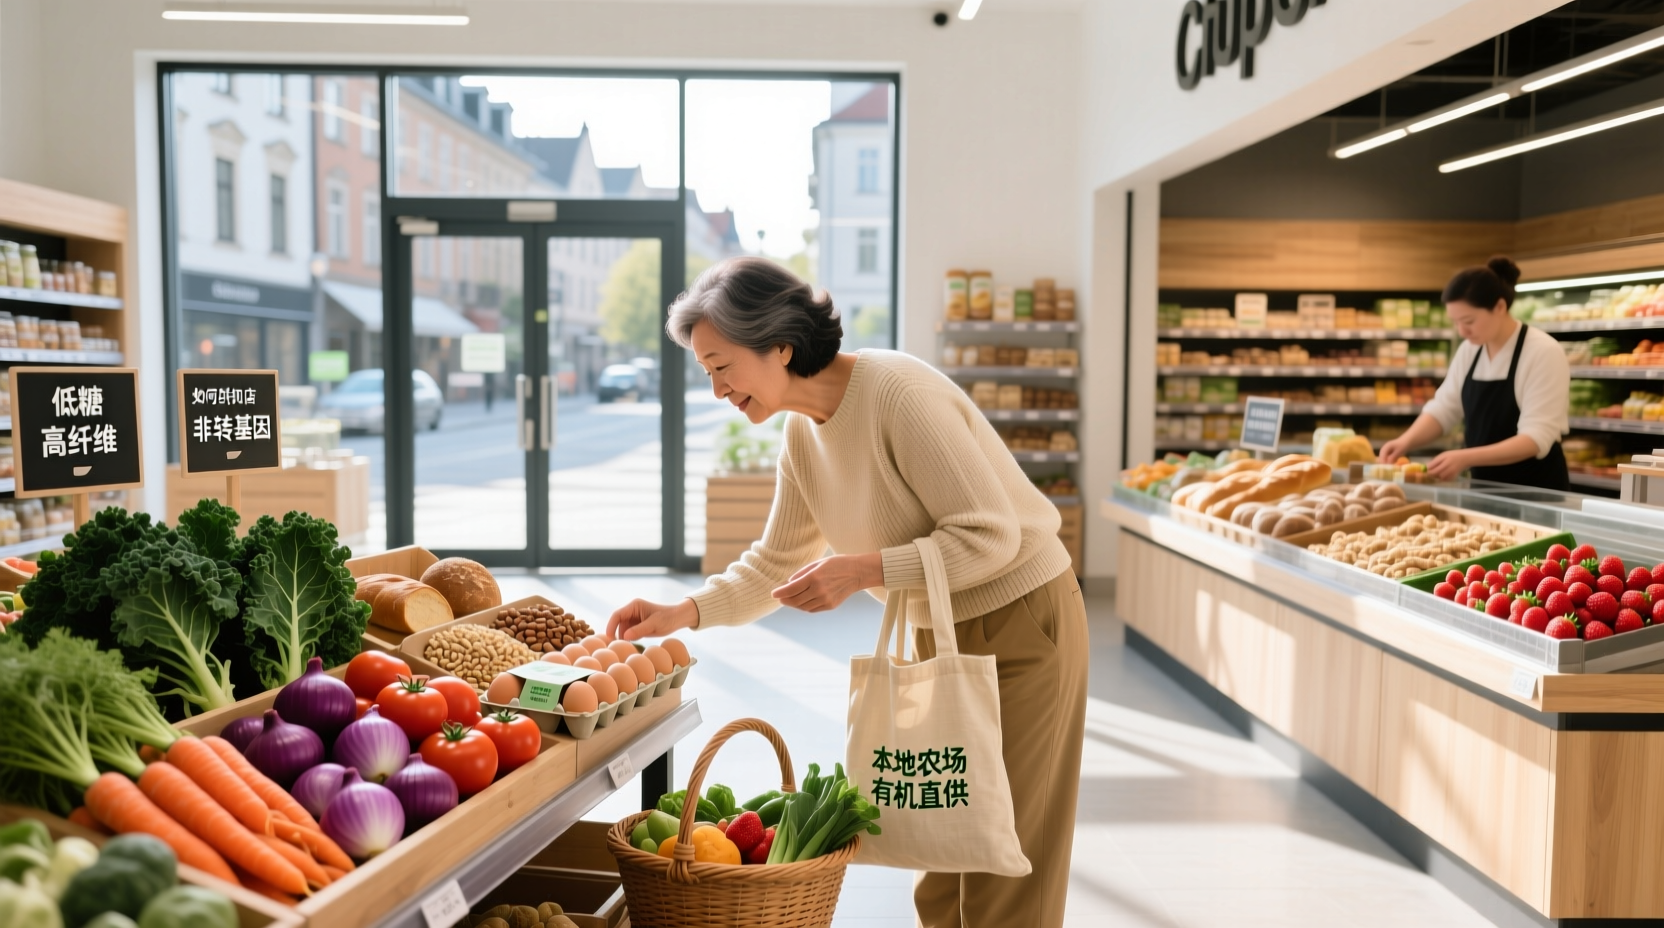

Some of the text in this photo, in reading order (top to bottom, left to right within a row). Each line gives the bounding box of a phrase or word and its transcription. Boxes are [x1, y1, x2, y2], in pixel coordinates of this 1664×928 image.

[52, 385, 103, 417] 低糖
[41, 424, 118, 458] 高纤维
[193, 413, 271, 442] 非转基因
[872, 745, 967, 777] 本地农场
[871, 777, 969, 809] 有机直供
